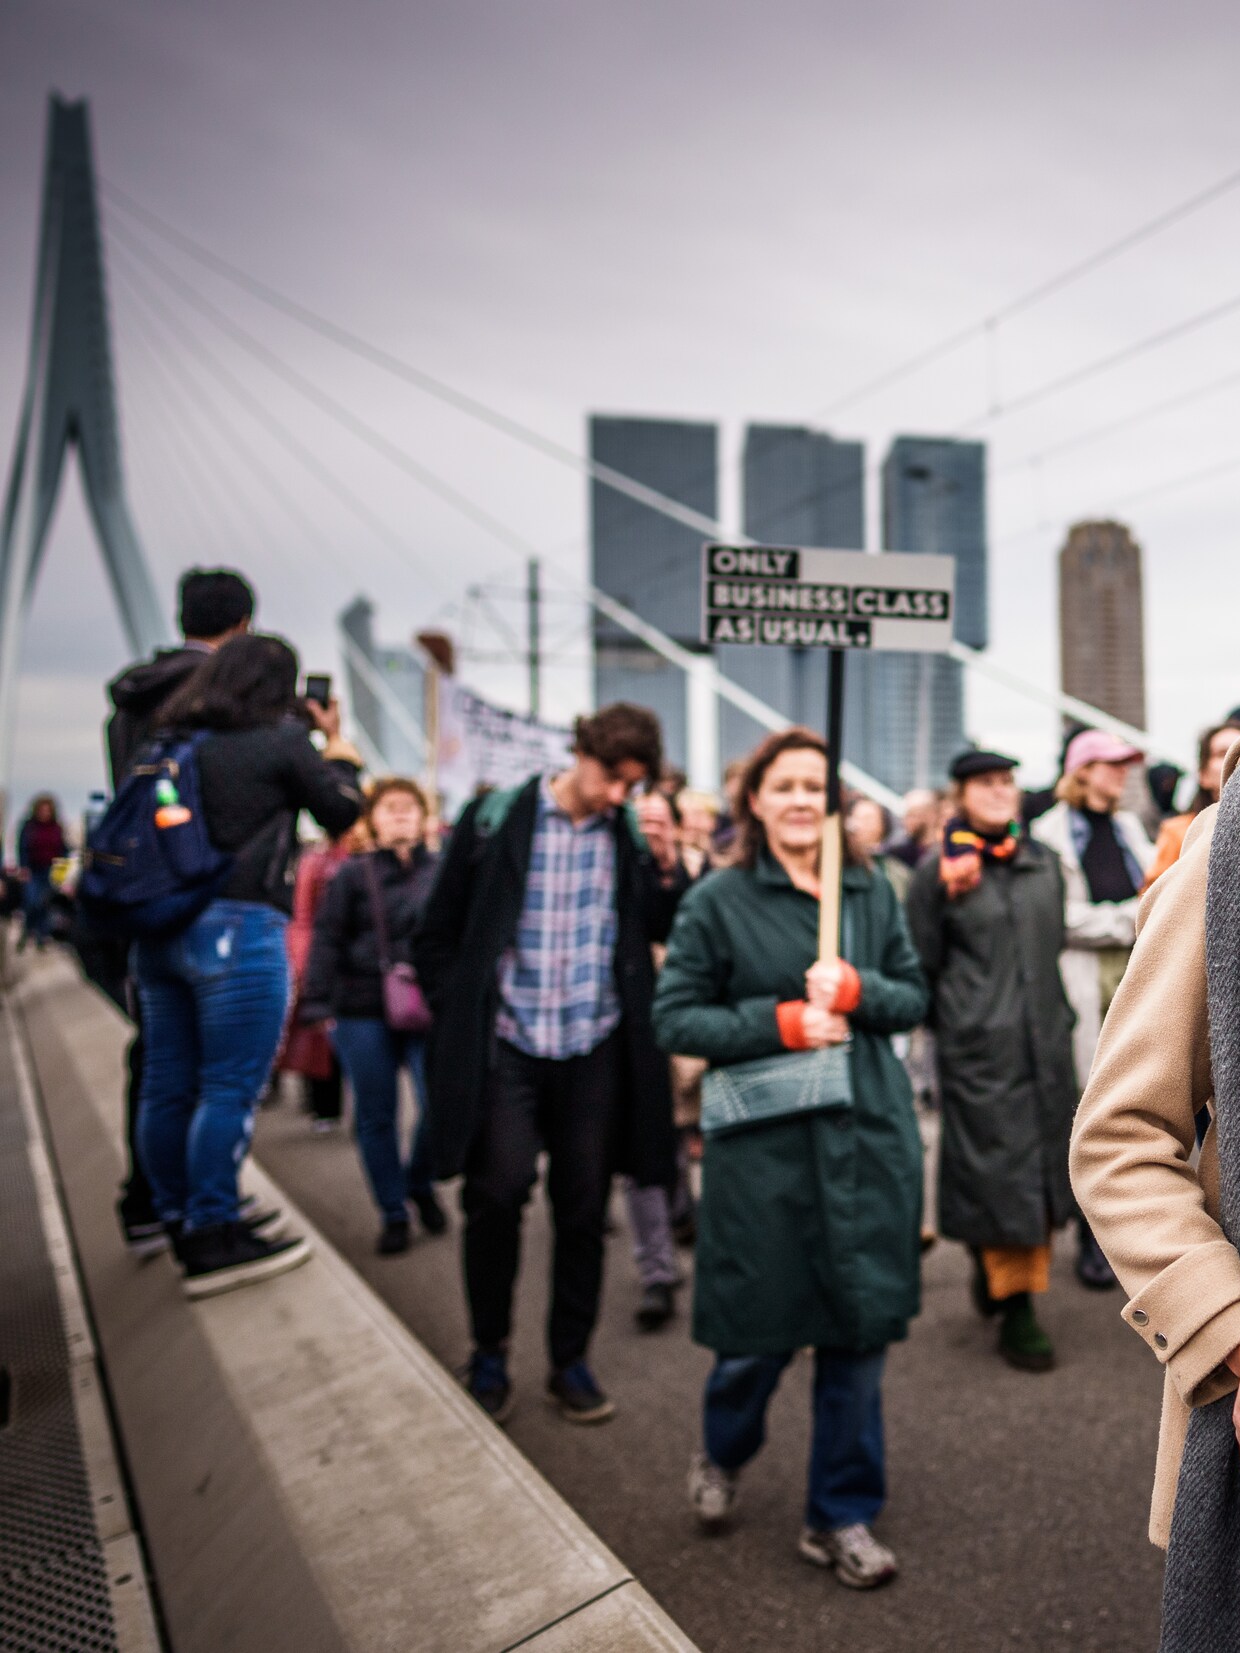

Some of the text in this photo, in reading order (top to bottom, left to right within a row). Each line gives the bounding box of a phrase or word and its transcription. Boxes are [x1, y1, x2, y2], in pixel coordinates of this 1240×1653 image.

[712, 551, 792, 575] ONLY
[712, 583, 945, 616] BUSINESS CLASS
[714, 617, 868, 645] AS USUAL.
